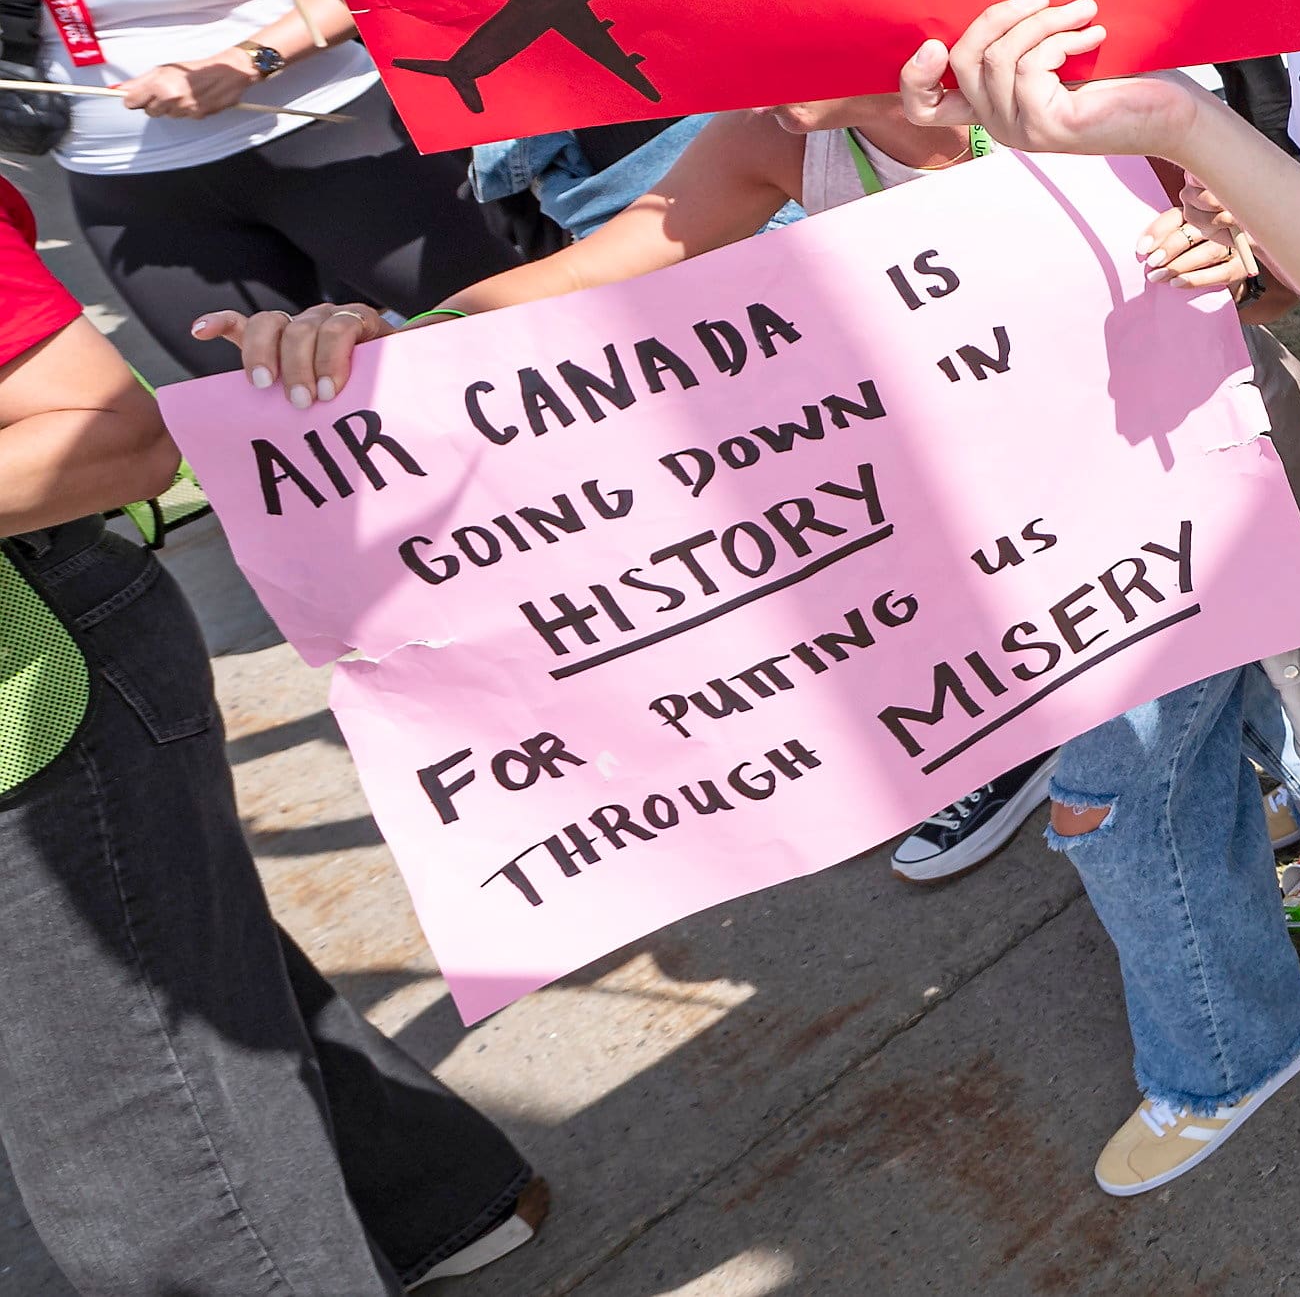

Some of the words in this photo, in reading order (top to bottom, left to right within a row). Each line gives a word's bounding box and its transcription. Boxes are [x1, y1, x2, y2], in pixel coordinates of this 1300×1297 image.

[251, 410, 427, 515] AIR
[465, 302, 803, 448] CANADA
[886, 249, 961, 311] IS
[399, 479, 633, 585] GOING
[660, 380, 888, 499] DOWN
[937, 326, 1011, 386] IN
[519, 461, 889, 657] HISTORY
[417, 731, 588, 825] FOR
[648, 588, 920, 741] PUTTING
[480, 738, 824, 908] THROUGH
[876, 518, 1199, 758] MISERY
